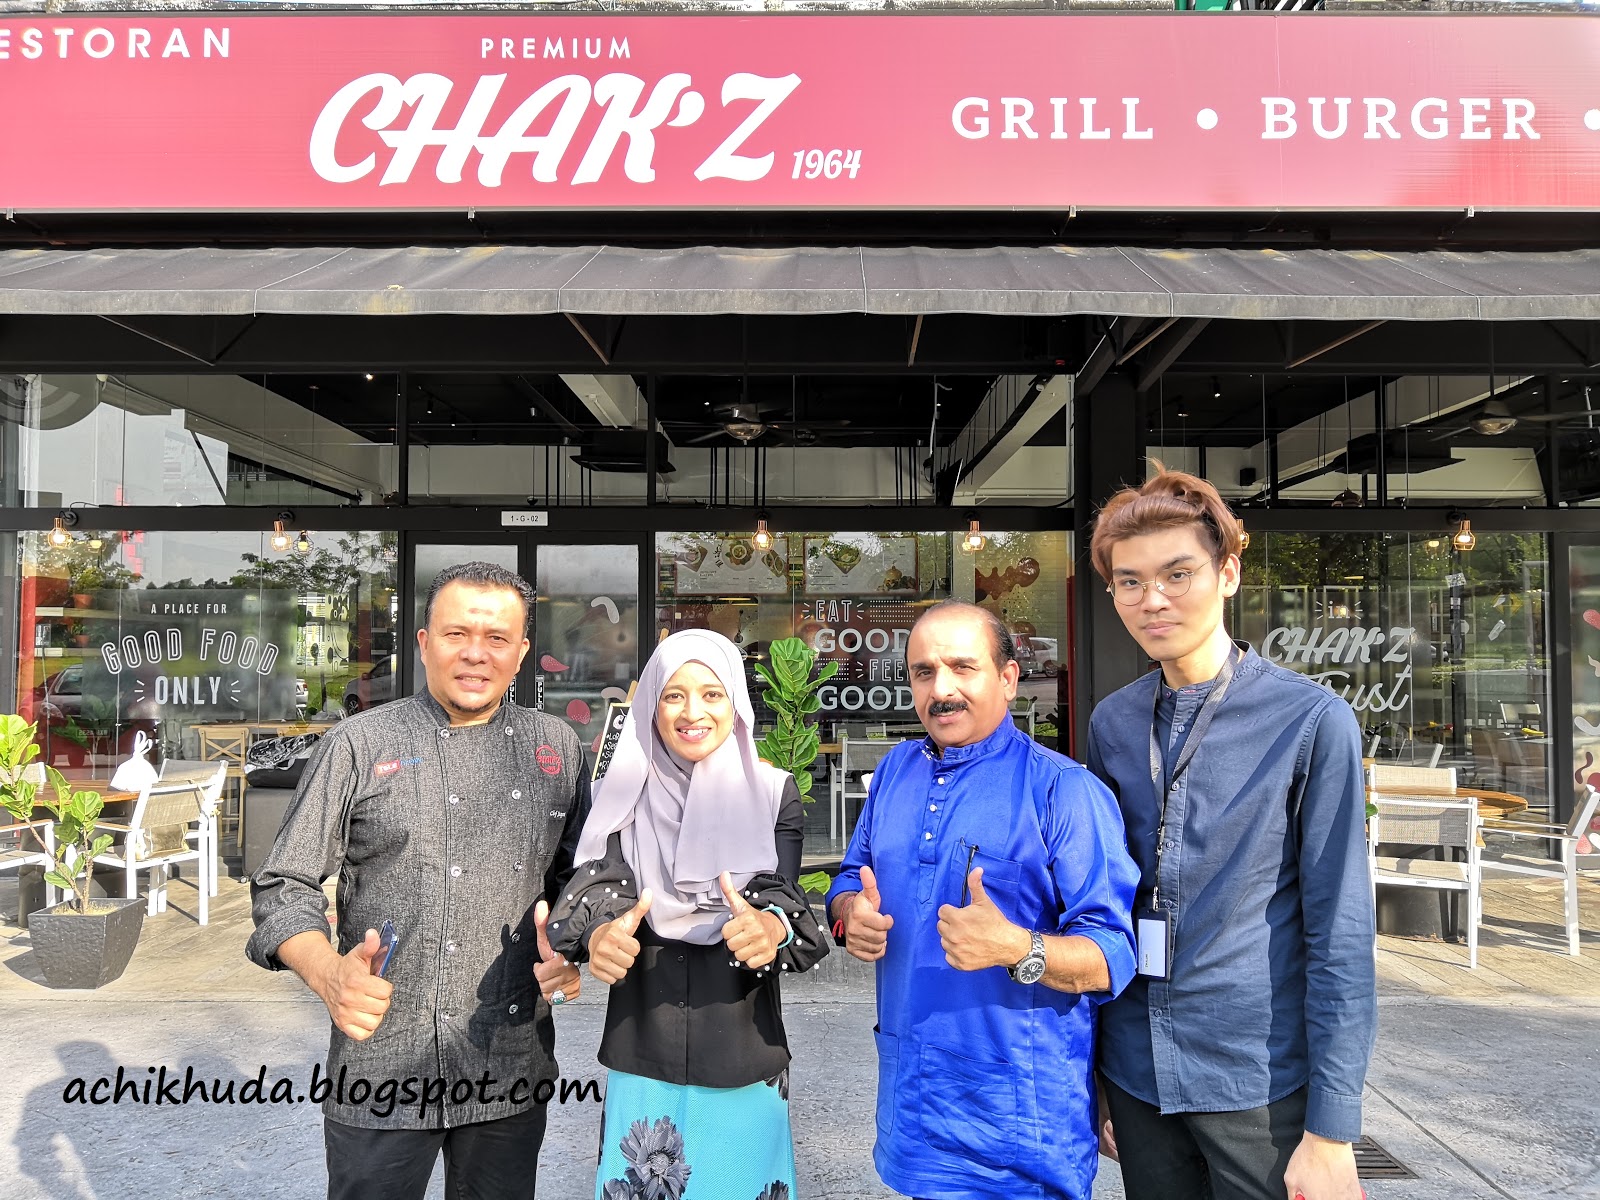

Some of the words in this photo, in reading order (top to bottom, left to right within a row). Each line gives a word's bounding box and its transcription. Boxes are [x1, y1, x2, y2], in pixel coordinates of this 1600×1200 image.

[480, 36, 632, 60] PREMIUM
[951, 96, 1155, 142] GRILL
[1260, 96, 1542, 142] BURGER
[791, 149, 863, 180] 1964
[151, 603, 157, 614] A
[164, 603, 199, 614] PLACE
[206, 603, 227, 614] FOR
[815, 600, 852, 622] EAT
[1328, 600, 1350, 619] in
[101, 628, 182, 674] GOOD
[200, 628, 279, 675] FOOD
[815, 628, 911, 653] GOOD
[869, 659, 909, 682] FEE
[155, 675, 221, 705] ONLY
[816, 685, 915, 711] GOOD
[1300, 664, 1412, 713] Tust
